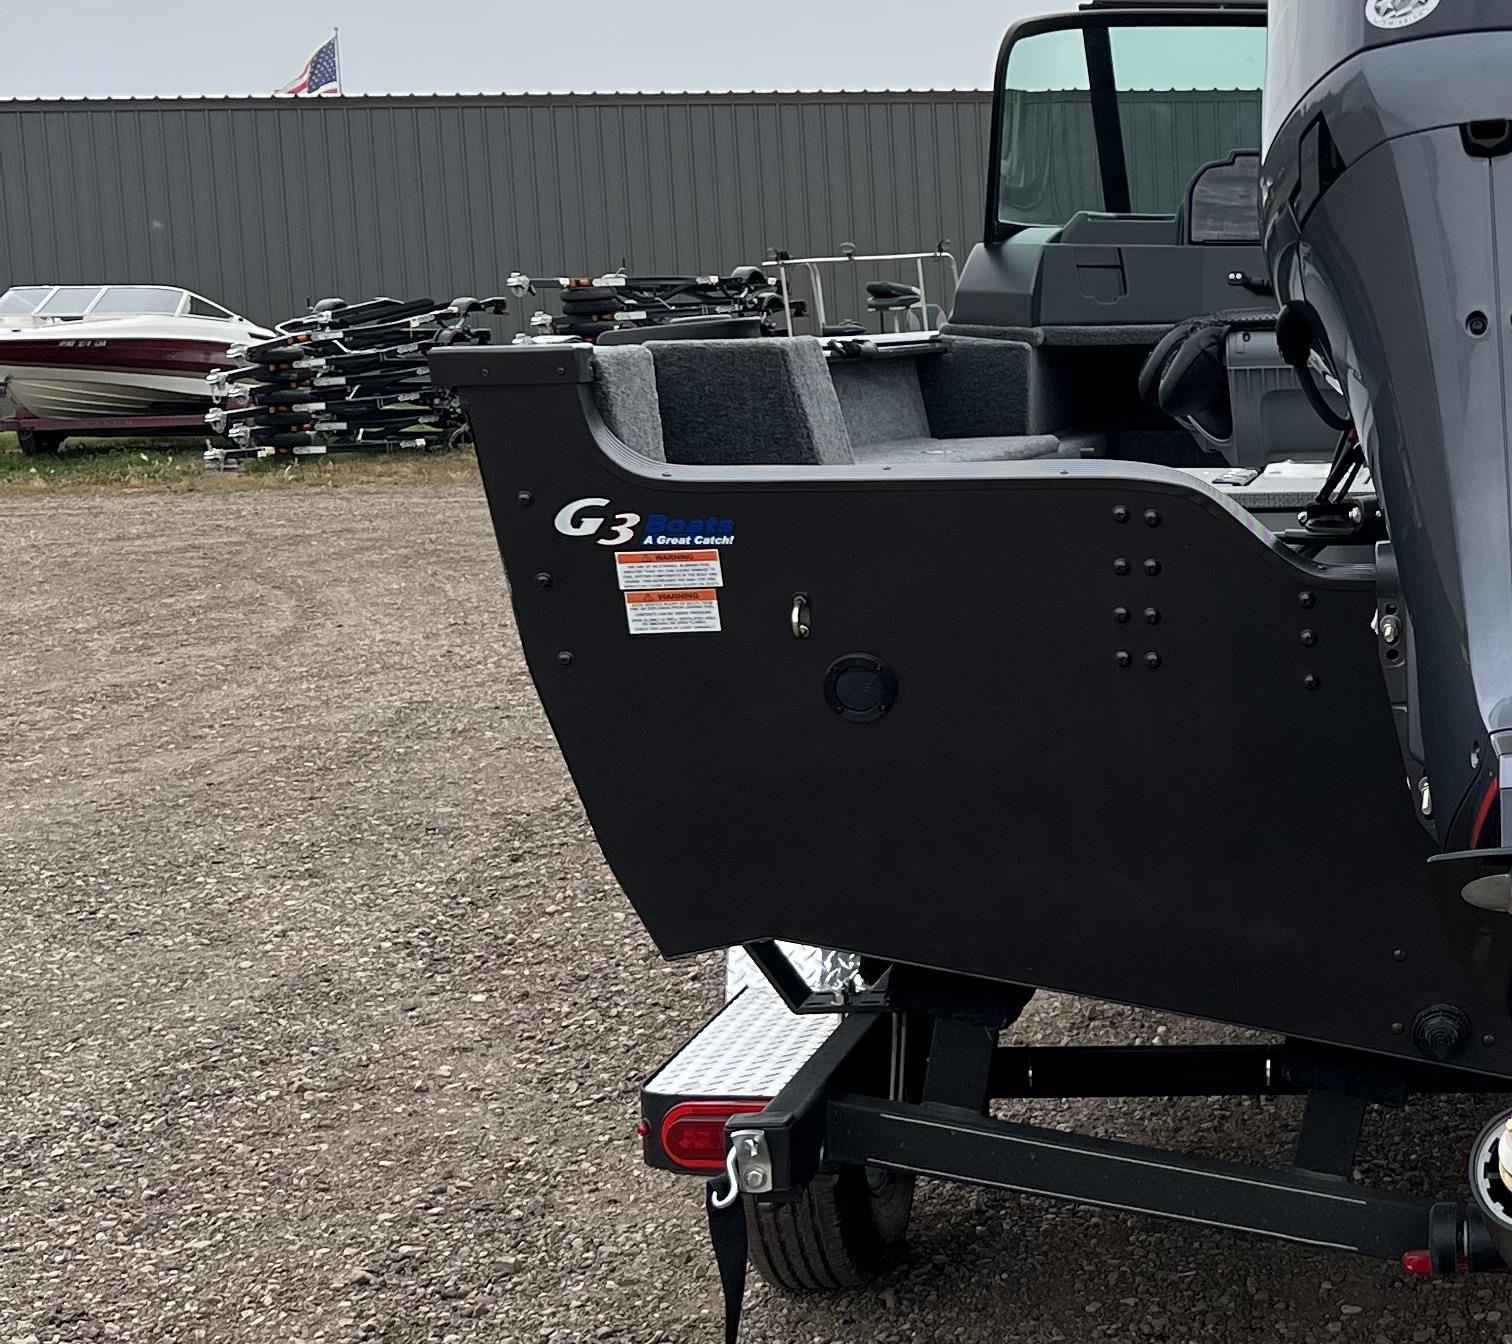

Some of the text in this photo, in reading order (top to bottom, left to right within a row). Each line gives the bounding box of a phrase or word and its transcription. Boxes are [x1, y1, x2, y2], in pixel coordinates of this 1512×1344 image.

[554, 497, 641, 546] G3
[643, 535, 735, 545] A Great Catch!
[657, 592, 700, 600] WARNING
